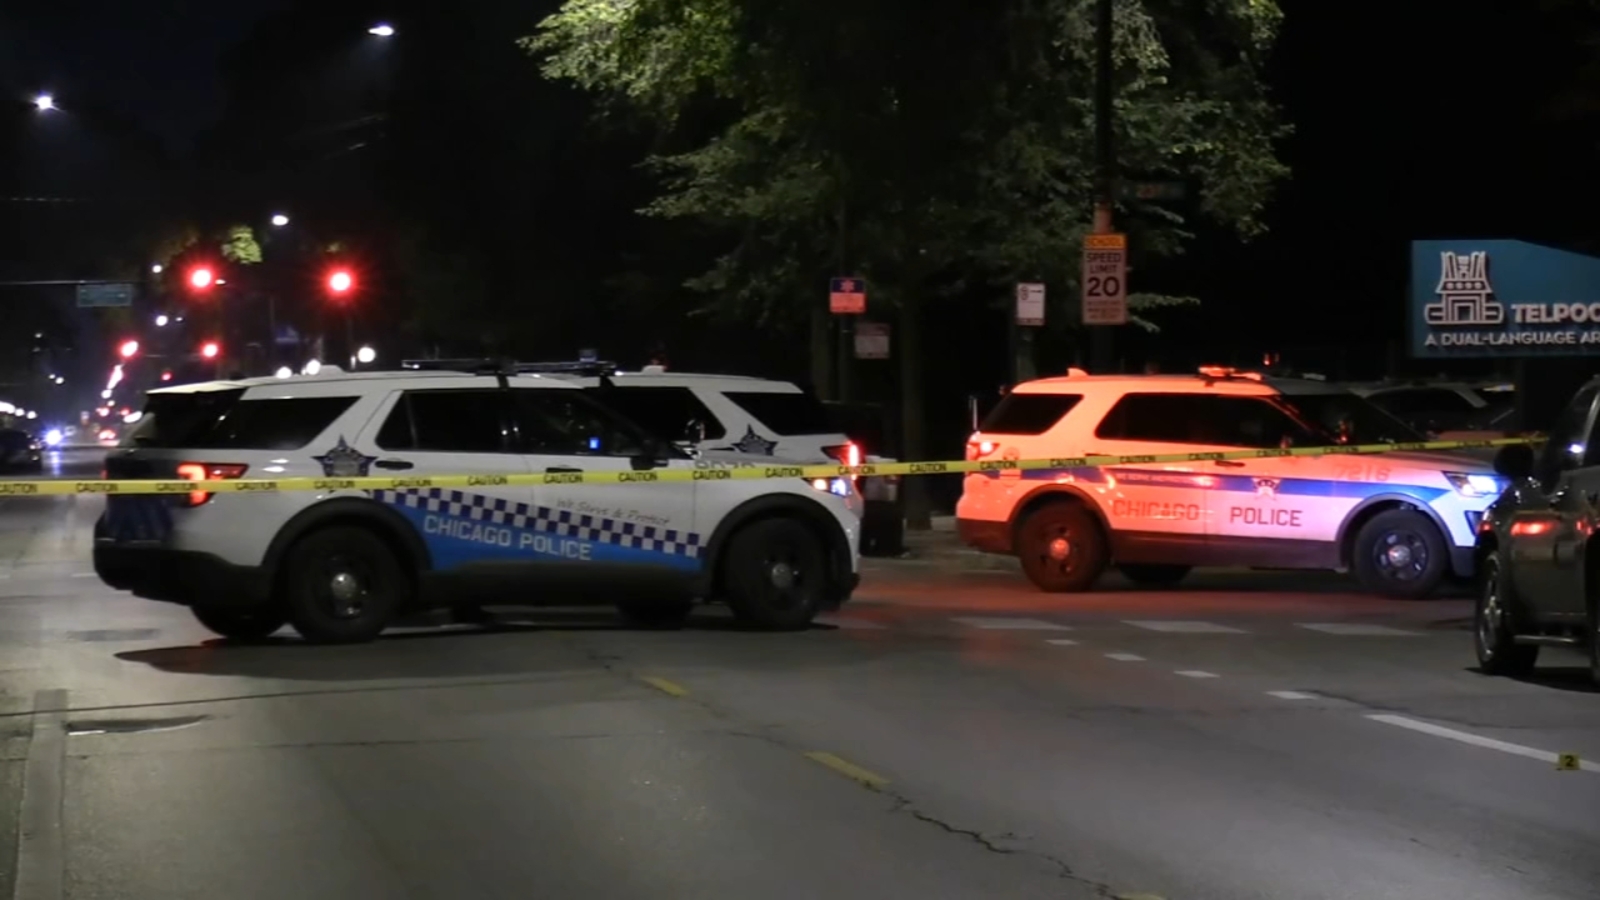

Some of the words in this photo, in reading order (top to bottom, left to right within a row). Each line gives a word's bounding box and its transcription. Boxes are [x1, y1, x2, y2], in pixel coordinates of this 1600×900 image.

[1087, 253, 1121, 262] SPEED
[1090, 264, 1117, 274] LIMIT
[1087, 276, 1120, 297] 20
[1424, 333, 1438, 346] A
[1441, 331, 1576, 346] DUAL-LANGUAGE
[75, 482, 118, 493] CAUTION
[156, 482, 199, 492] CAUTION
[235, 481, 277, 491] CAUTION
[314, 480, 355, 490] CAUTION
[391, 478, 431, 488] CAUTION
[467, 475, 507, 486] CAUTION
[543, 473, 583, 485] CAUTION
[618, 472, 657, 482] CAUTION
[692, 470, 731, 481] CAUTION
[765, 467, 803, 478] CAUTION
[838, 465, 875, 475] CAUTION
[909, 462, 947, 473] CAUTION
[980, 460, 1017, 470] CAUTION
[1050, 458, 1087, 468] CAUTION
[1113, 500, 1200, 521] CHICAGO
[1230, 506, 1303, 527] POLICE
[423, 514, 511, 547] CHICAGO
[519, 532, 592, 561] POLICE
[1565, 754, 1575, 767] 2
